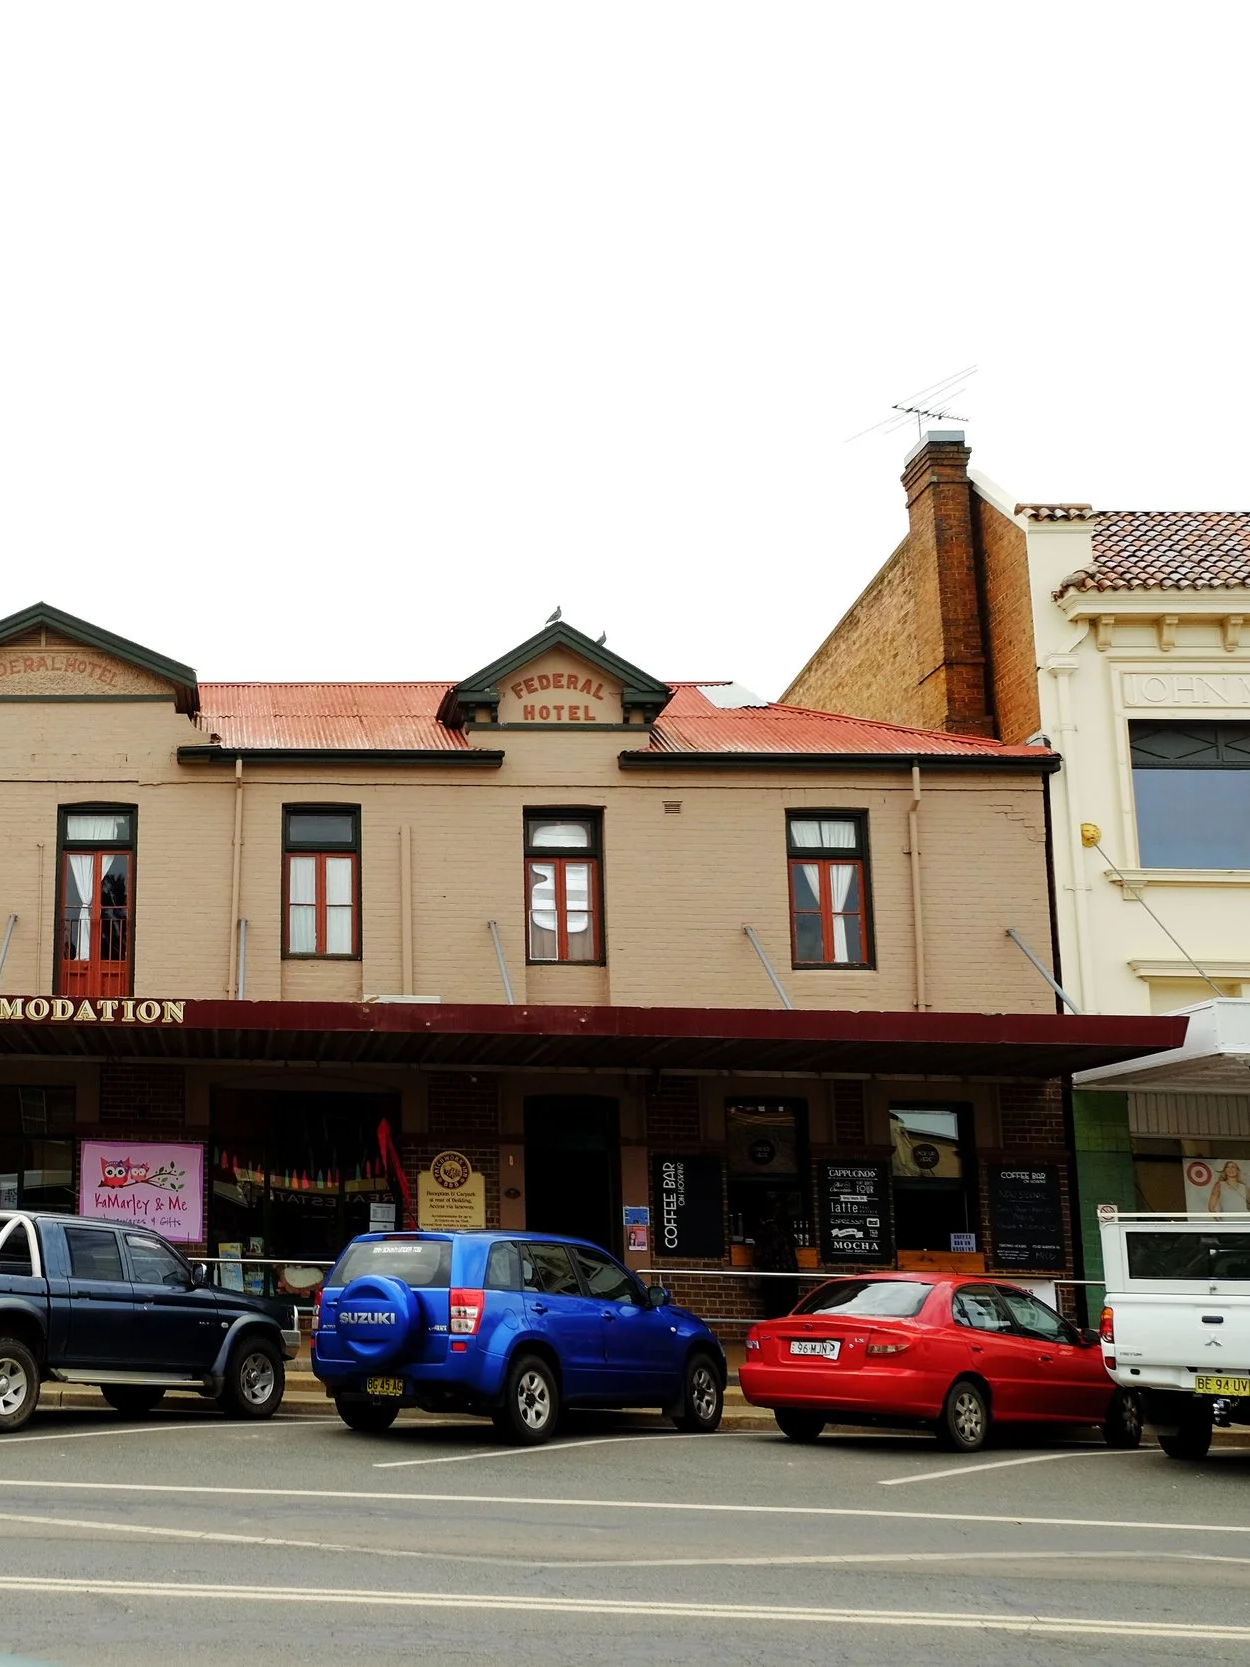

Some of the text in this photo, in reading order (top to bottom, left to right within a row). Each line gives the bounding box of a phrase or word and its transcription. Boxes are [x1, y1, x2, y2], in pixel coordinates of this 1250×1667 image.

[64, 657, 119, 688] HOTEL
[511, 673, 603, 701] FEDERAL
[1126, 674, 1229, 705] JOHN
[523, 704, 596, 721] HOTEL
[1000, 1171, 1030, 1179] COFFEE
[94, 1193, 188, 1215] KaMarley & Me
[662, 1162, 678, 1248] COFFEE BAR
[678, 1196, 685, 1206] ON
[831, 1202, 858, 1213] latte
[159, 1217, 181, 1227] Gifts
[833, 1241, 879, 1250] MOCHA
[339, 1312, 396, 1325] SUZUKI
[1197, 1378, 1248, 1391] BE 94 UV
